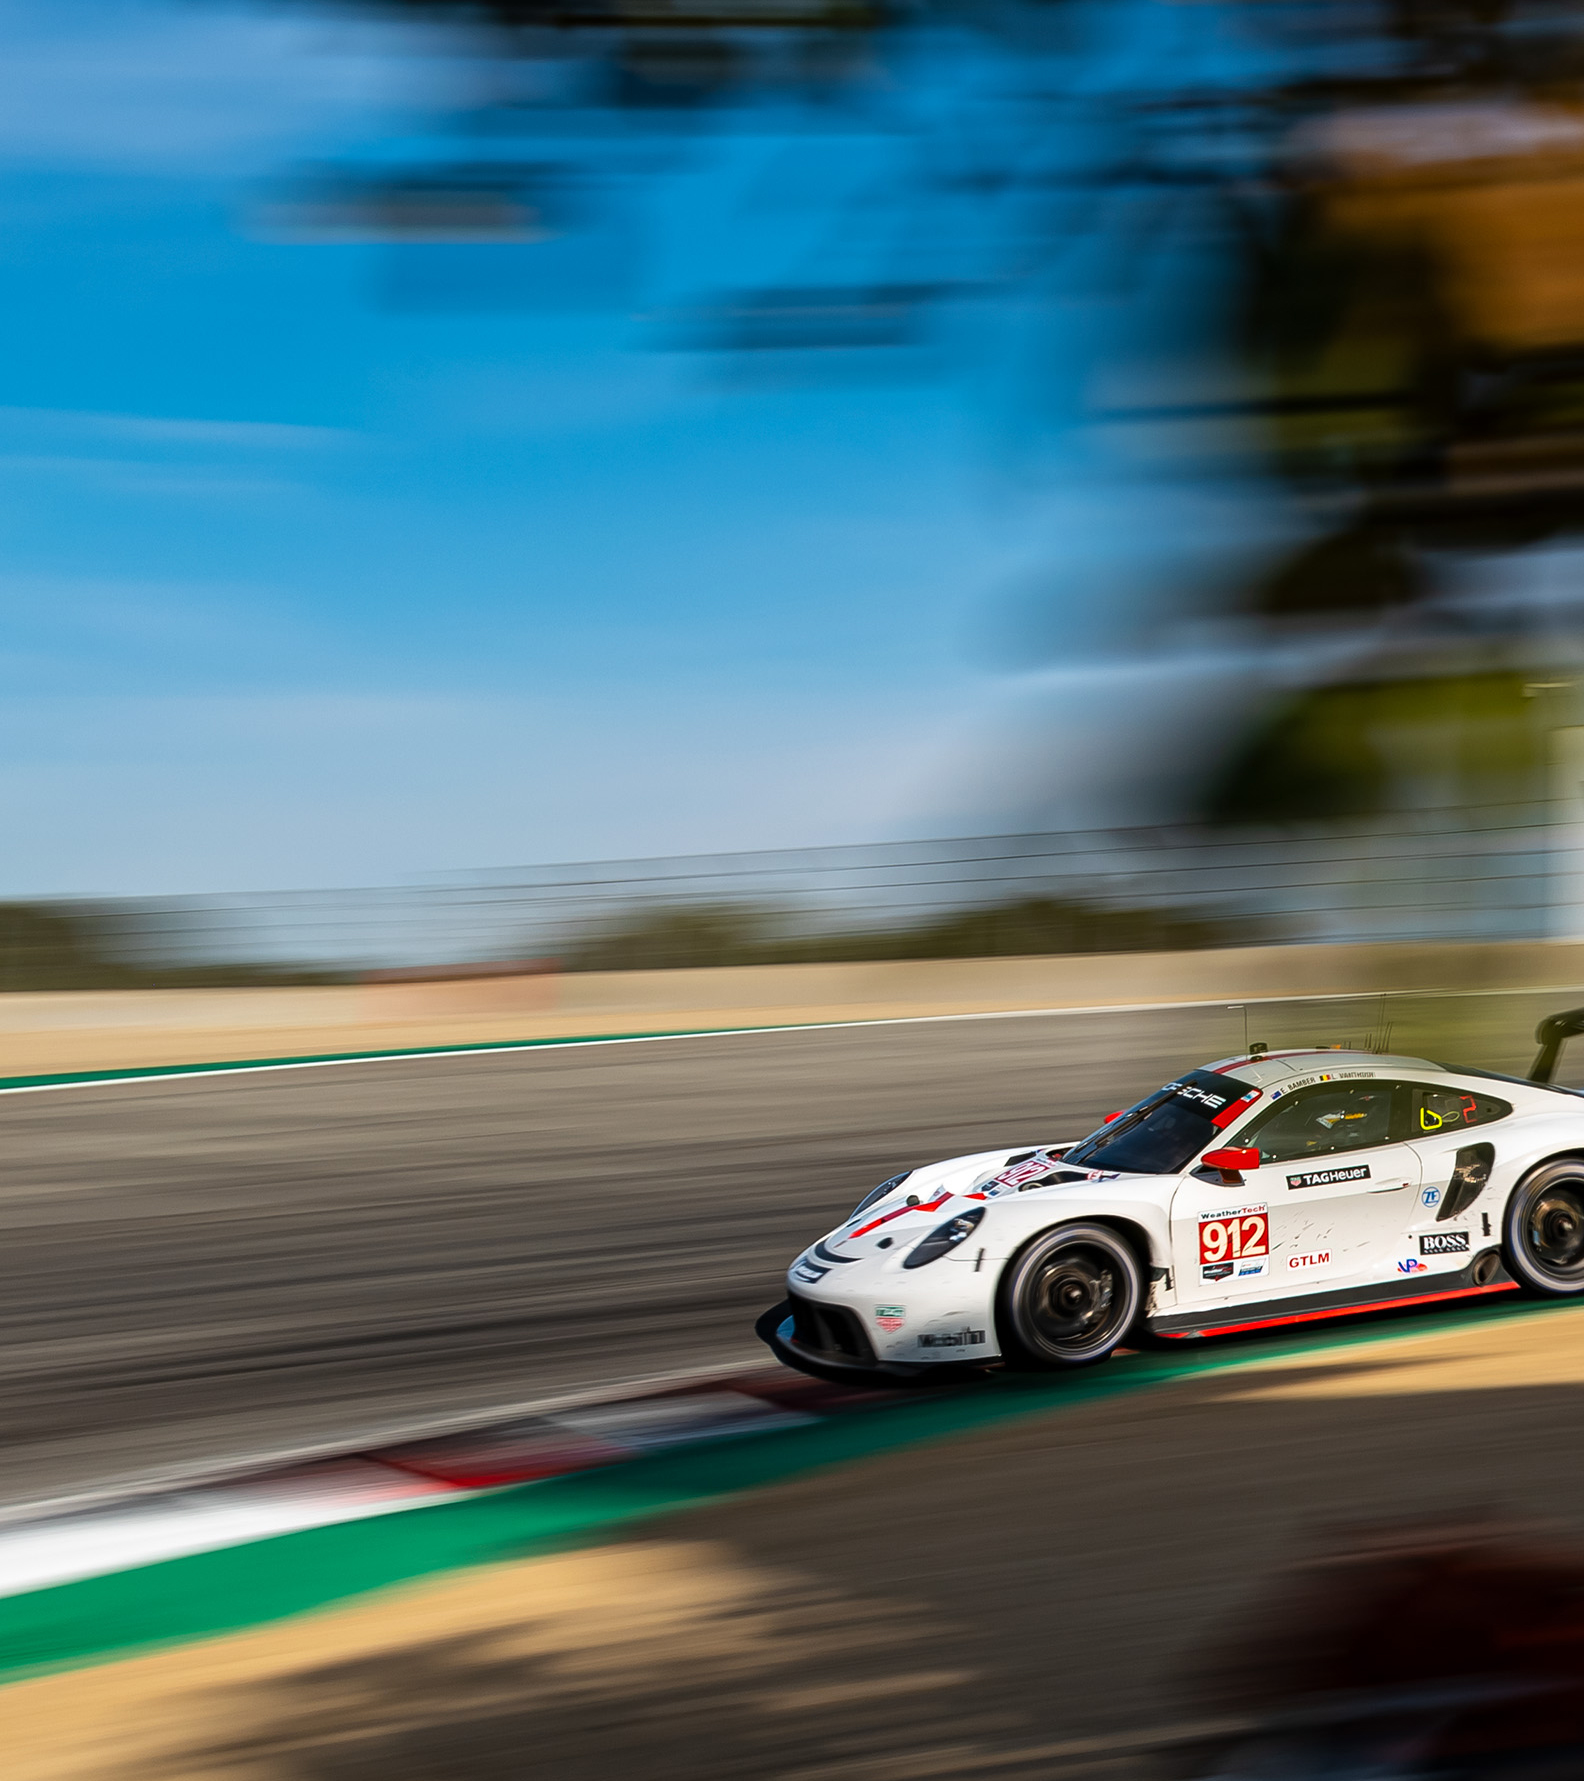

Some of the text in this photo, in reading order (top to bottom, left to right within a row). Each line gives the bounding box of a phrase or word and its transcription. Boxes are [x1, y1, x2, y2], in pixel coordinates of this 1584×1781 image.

[1287, 1077, 1316, 1091] BAMBER
[1424, 1189, 1440, 1204] ZF
[1201, 1205, 1266, 1219] WeatherTech
[1202, 1216, 1266, 1262] 912
[1423, 1234, 1467, 1249] BOSS
[1289, 1252, 1329, 1268] GTLM
[1398, 1259, 1418, 1273] VP
